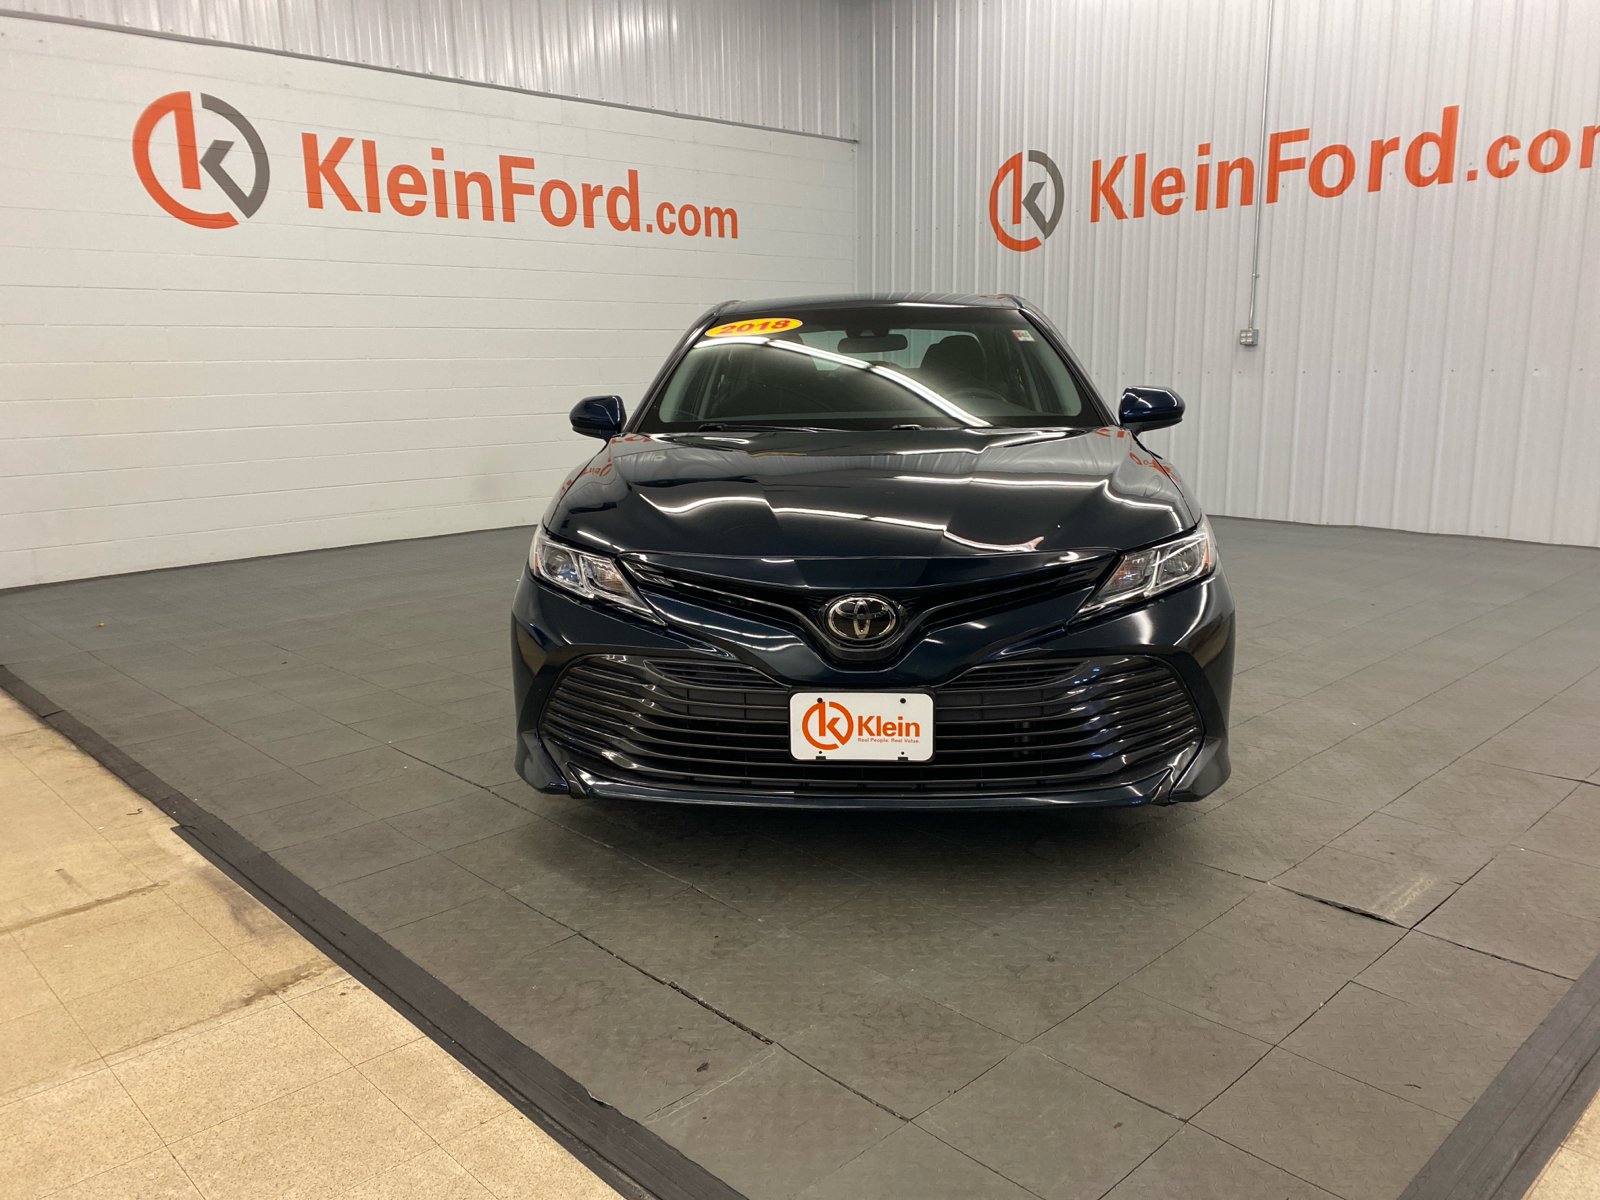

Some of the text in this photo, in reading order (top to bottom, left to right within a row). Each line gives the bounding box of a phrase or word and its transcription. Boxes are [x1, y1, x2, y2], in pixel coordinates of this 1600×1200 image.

[300, 131, 739, 240] KleinFord.com
[716, 319, 791, 335] 2018
[857, 715, 920, 737] Klein
